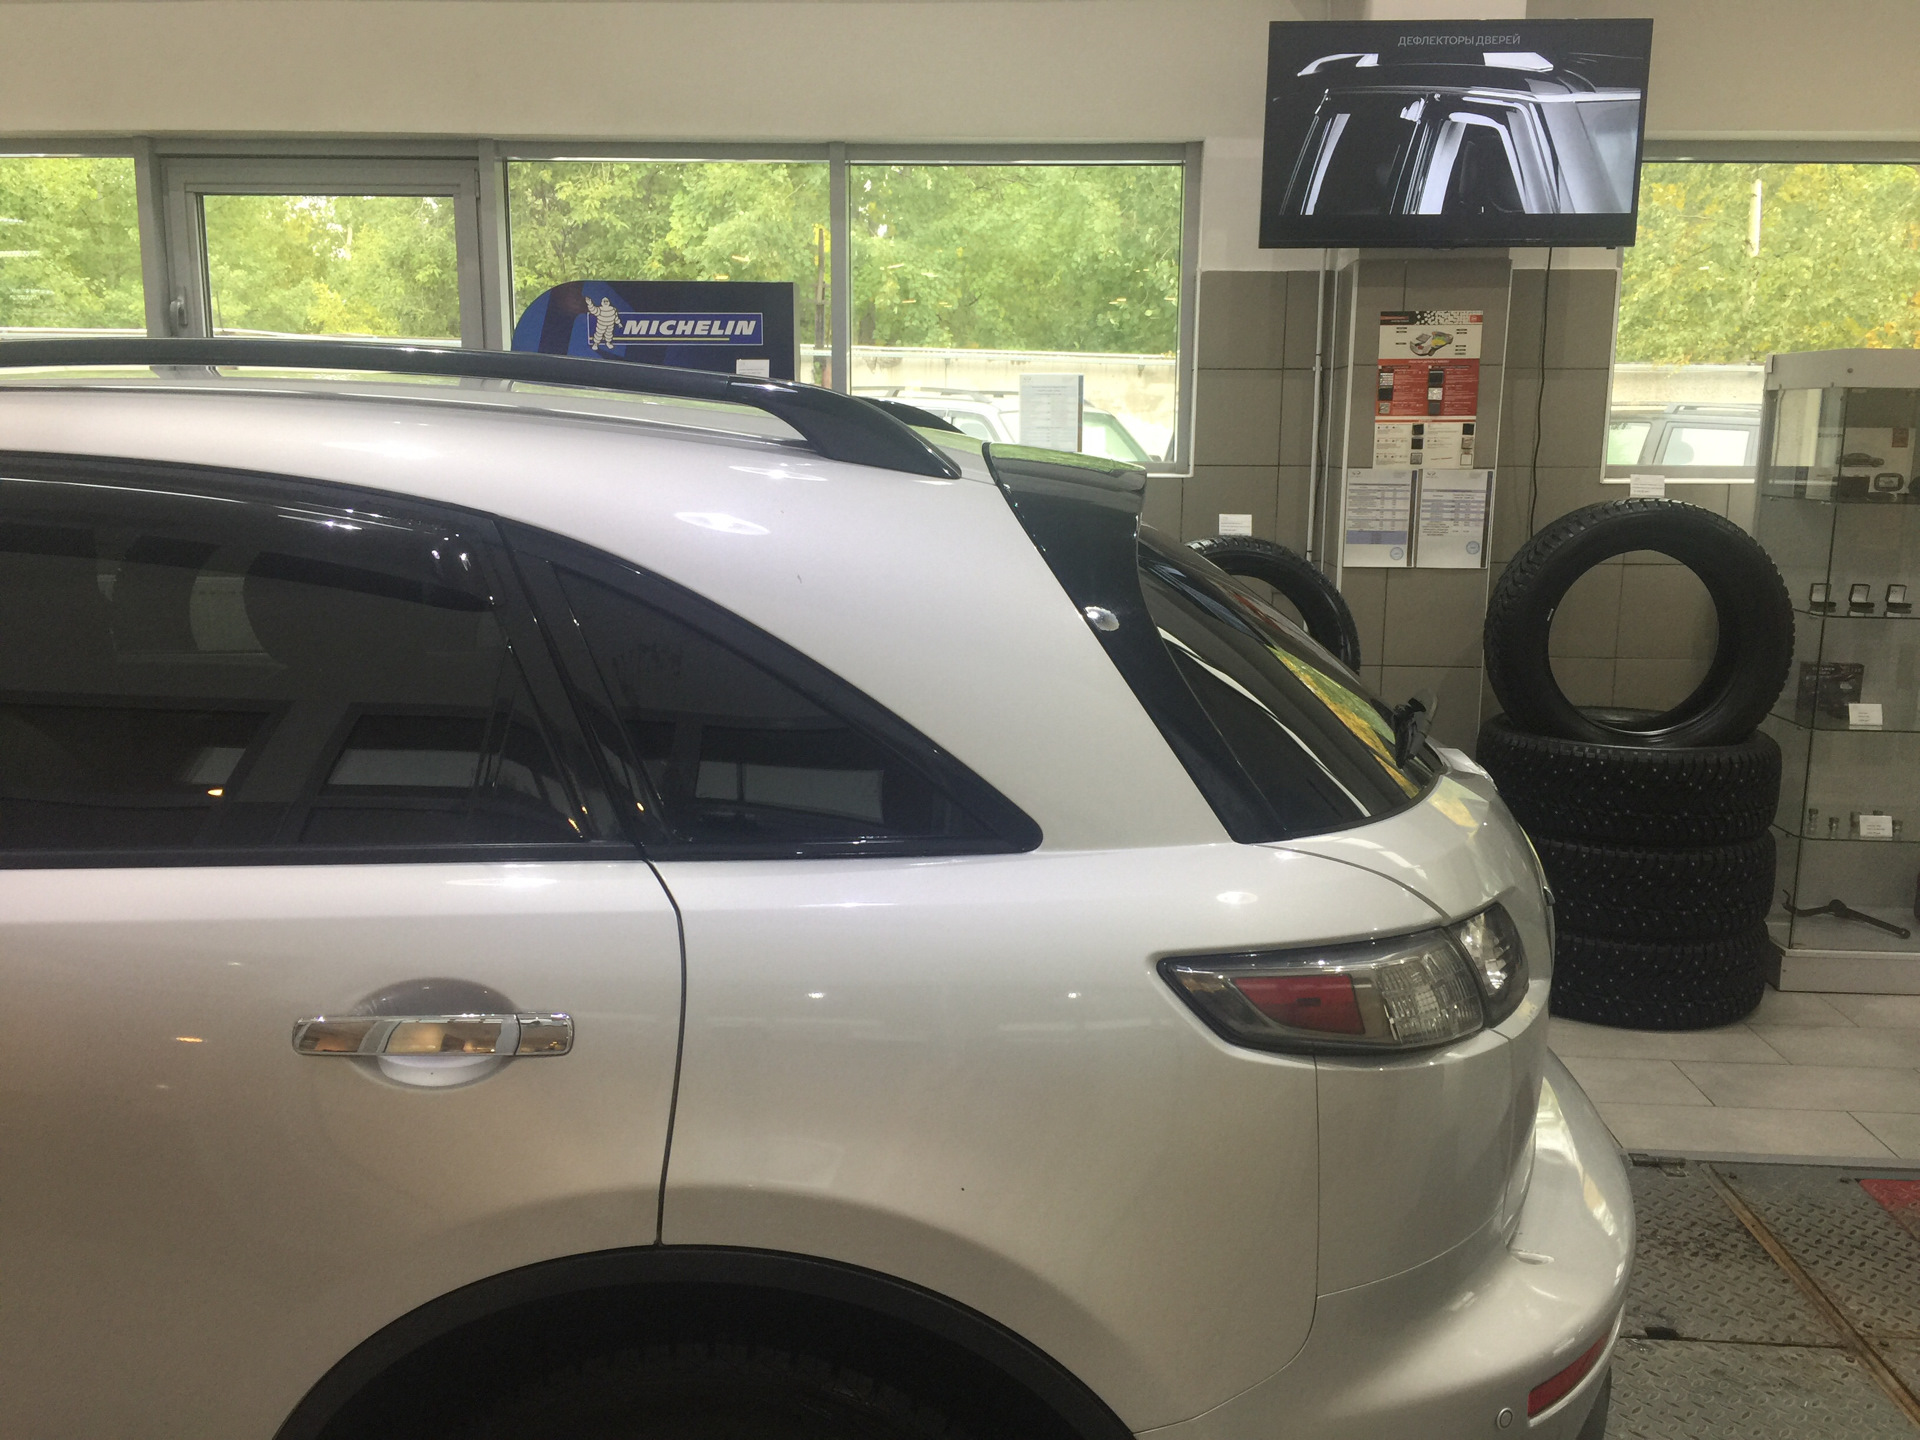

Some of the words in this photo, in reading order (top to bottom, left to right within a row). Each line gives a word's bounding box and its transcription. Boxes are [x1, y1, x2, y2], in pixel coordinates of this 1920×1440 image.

[1397, 35, 1474, 47] ДЕФЛЕКТОРЫ
[1475, 33, 1521, 47] ДВЕРЕЙ
[622, 320, 757, 336] MICHELIN
